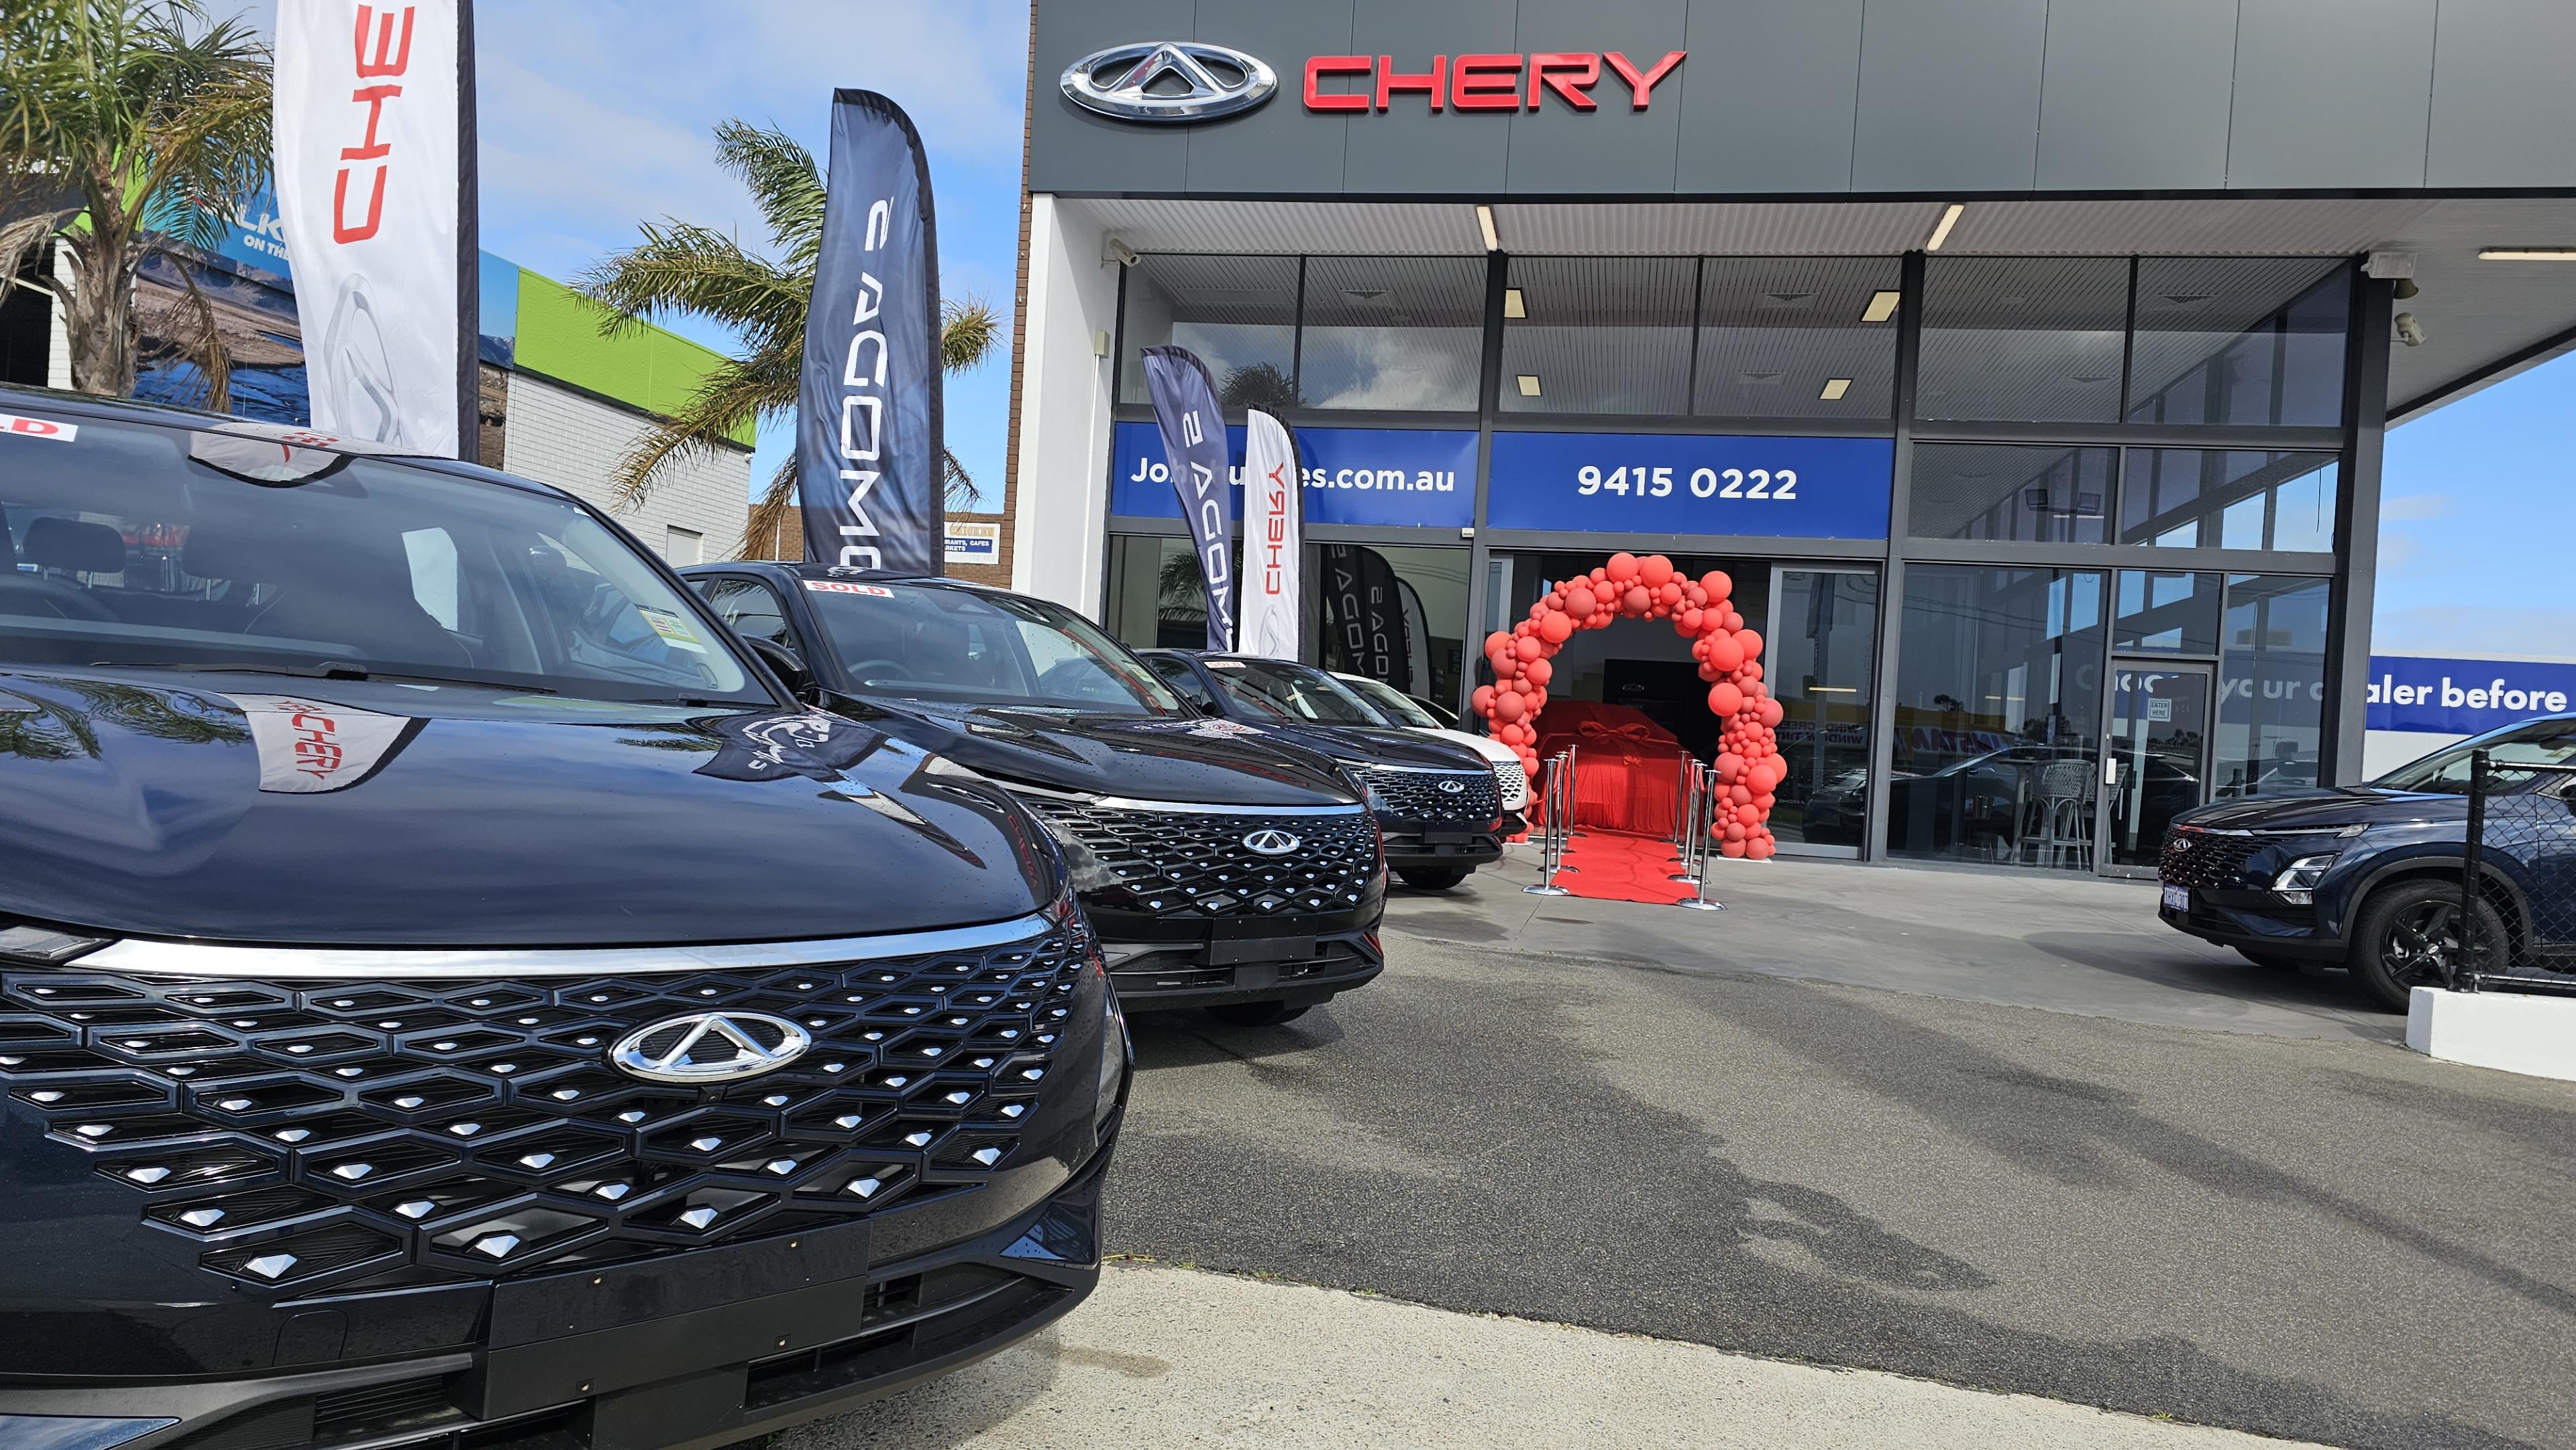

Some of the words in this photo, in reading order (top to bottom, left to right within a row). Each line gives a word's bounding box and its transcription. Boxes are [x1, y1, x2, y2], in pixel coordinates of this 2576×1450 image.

[1303, 51, 1687, 111] CHERY
[244, 235, 265, 252] ON
[1578, 465, 1672, 497] 9415
[1690, 467, 1796, 500] 0222
[812, 581, 886, 596] SOLD
[2441, 677, 2567, 712] before
